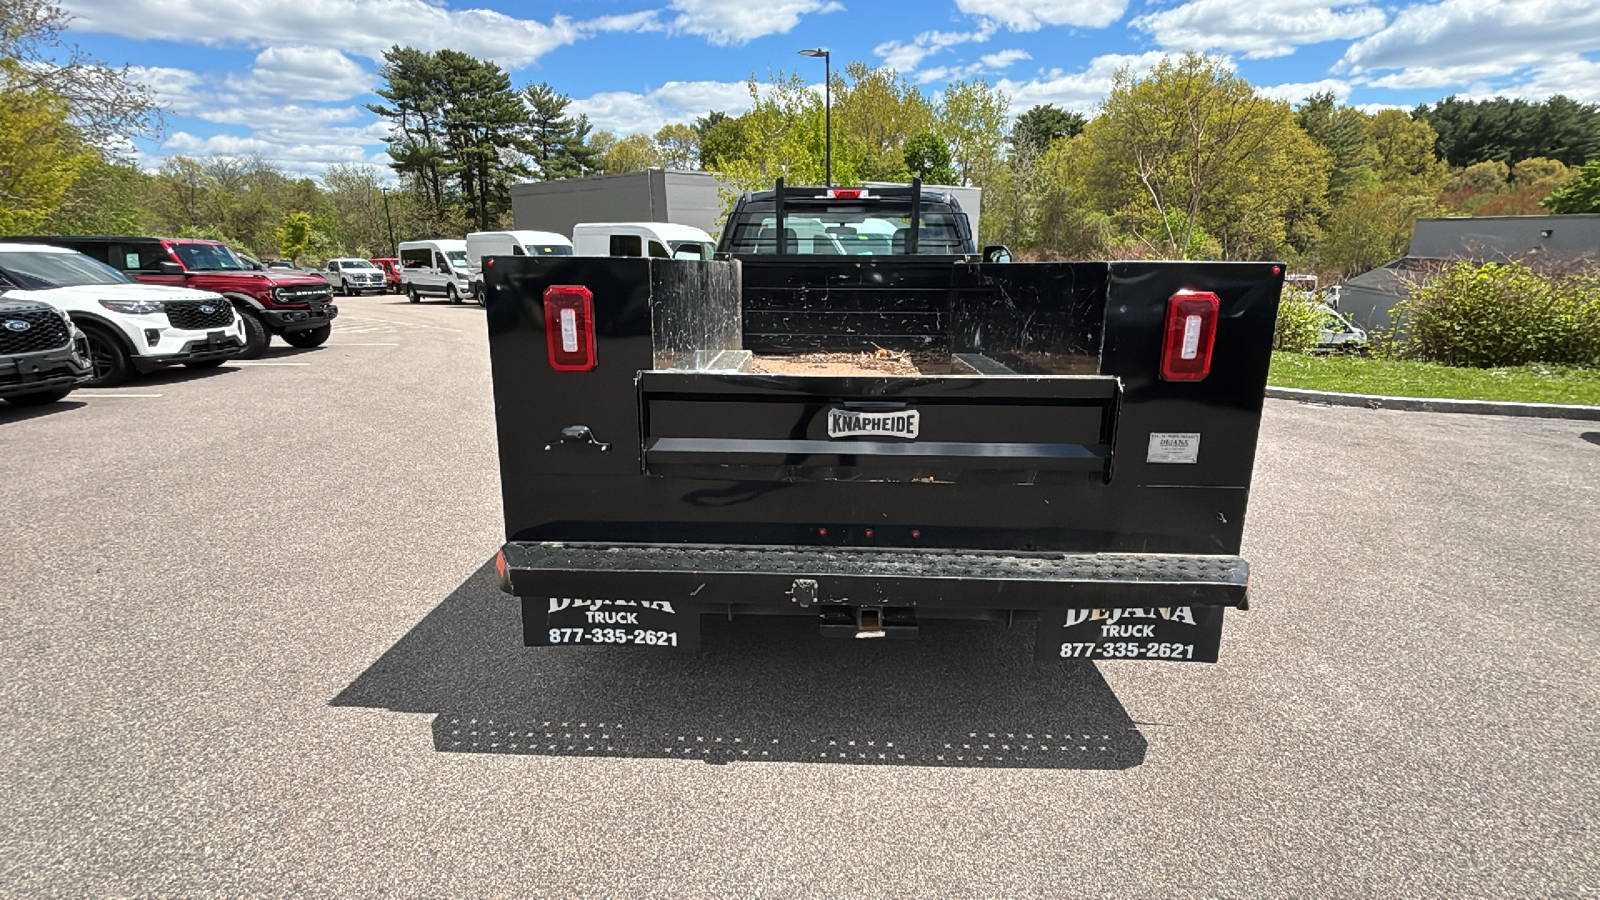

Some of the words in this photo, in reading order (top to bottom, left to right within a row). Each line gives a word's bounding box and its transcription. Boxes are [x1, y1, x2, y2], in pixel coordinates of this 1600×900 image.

[832, 413, 915, 434] KNAPHEIDE
[585, 611, 639, 624] TRUCK
[548, 628, 678, 647] 877-335-2621
[1100, 624, 1156, 637] TRUCK
[1059, 642, 1194, 659] 877-335-2621
